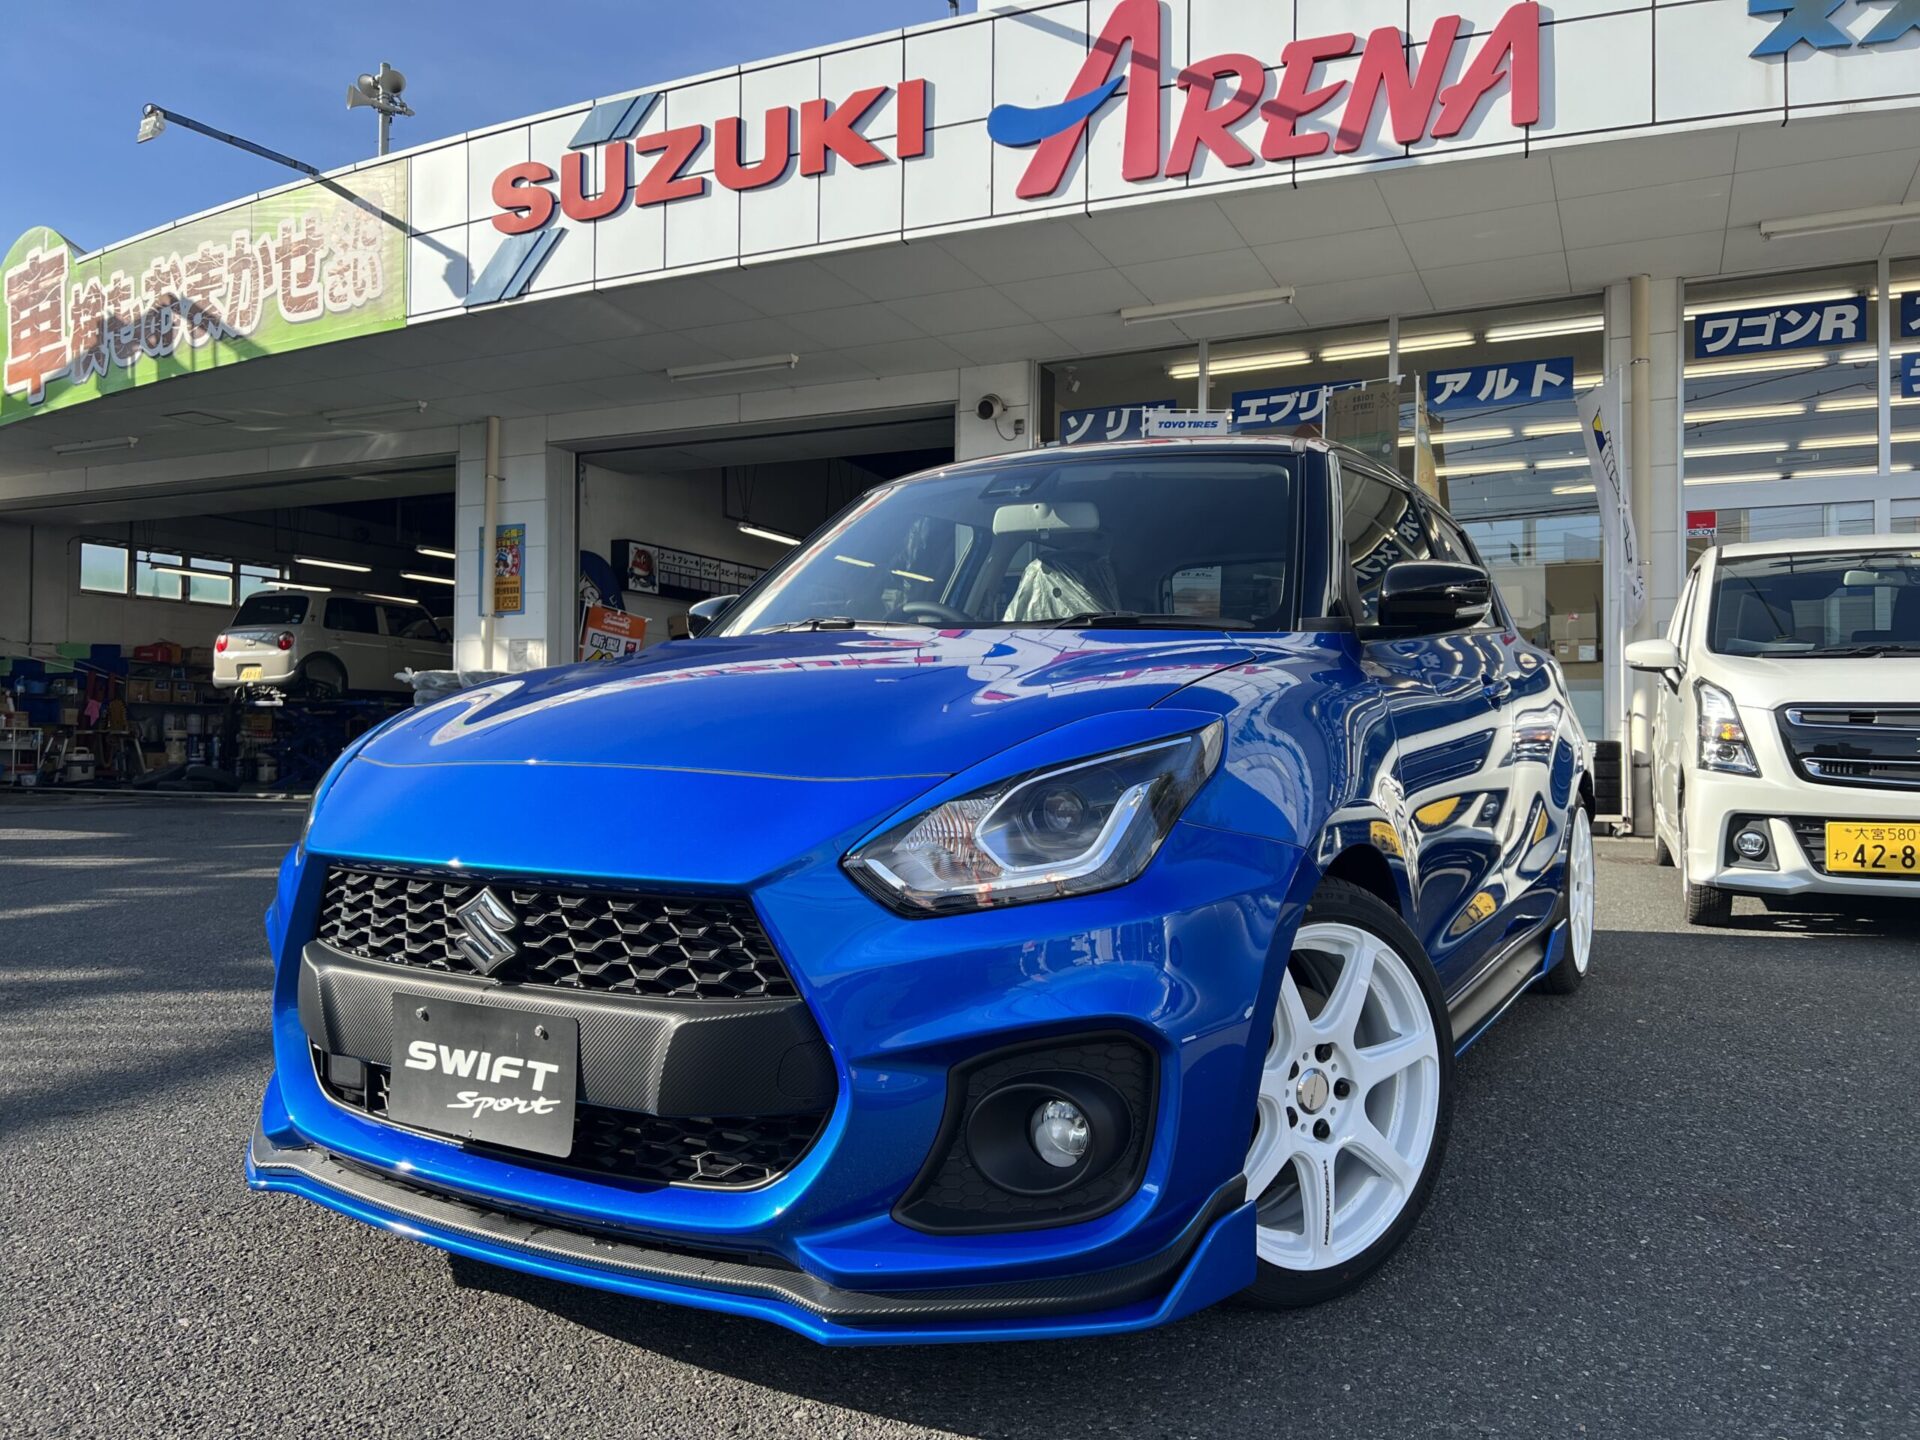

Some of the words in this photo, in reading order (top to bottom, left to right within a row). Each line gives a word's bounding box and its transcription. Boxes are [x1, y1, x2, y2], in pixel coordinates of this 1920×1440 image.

[491, 78, 926, 236] SUZUKI
[987, 0, 1540, 199] ARENA
[1702, 304, 1859, 352] ワゴンR
[1434, 363, 1565, 405] アルト
[1158, 421, 1186, 429] TOYO
[1187, 420, 1218, 429] TIRES
[590, 633, 620, 652] 新型
[405, 1040, 559, 1092] SWIFT
[447, 1091, 561, 1118] Sport
